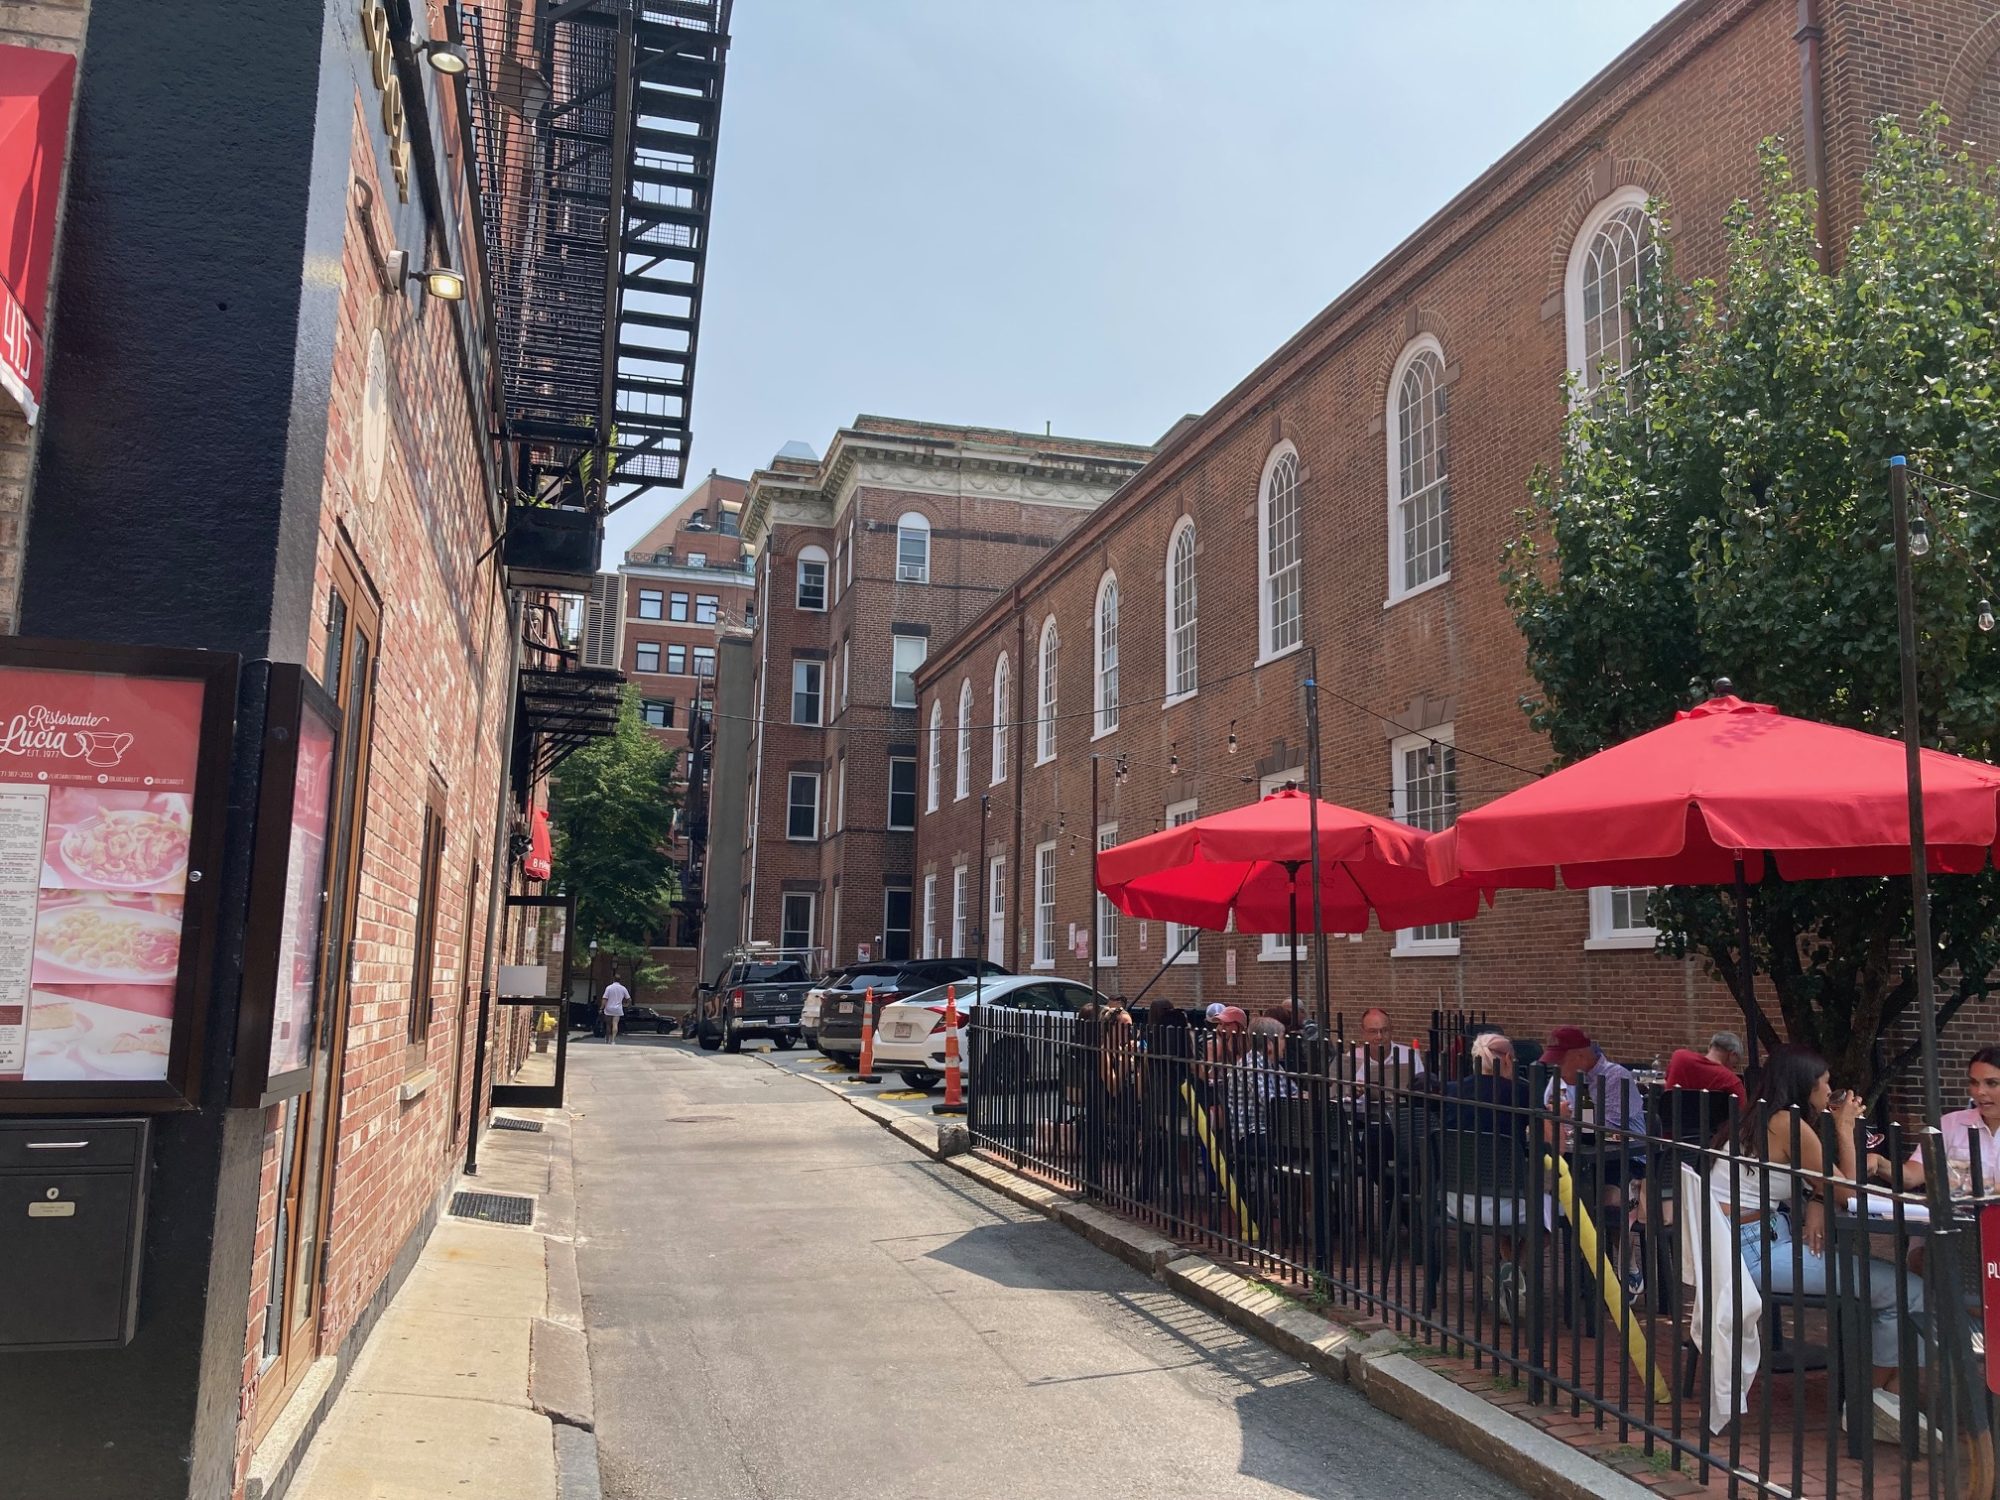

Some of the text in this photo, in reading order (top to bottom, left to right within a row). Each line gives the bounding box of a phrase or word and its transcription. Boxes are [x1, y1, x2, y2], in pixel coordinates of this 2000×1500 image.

[4, 291, 31, 379] 415
[28, 705, 109, 731] Ristorante
[0, 715, 88, 757] Lucia
[43, 750, 60, 758] 1977
